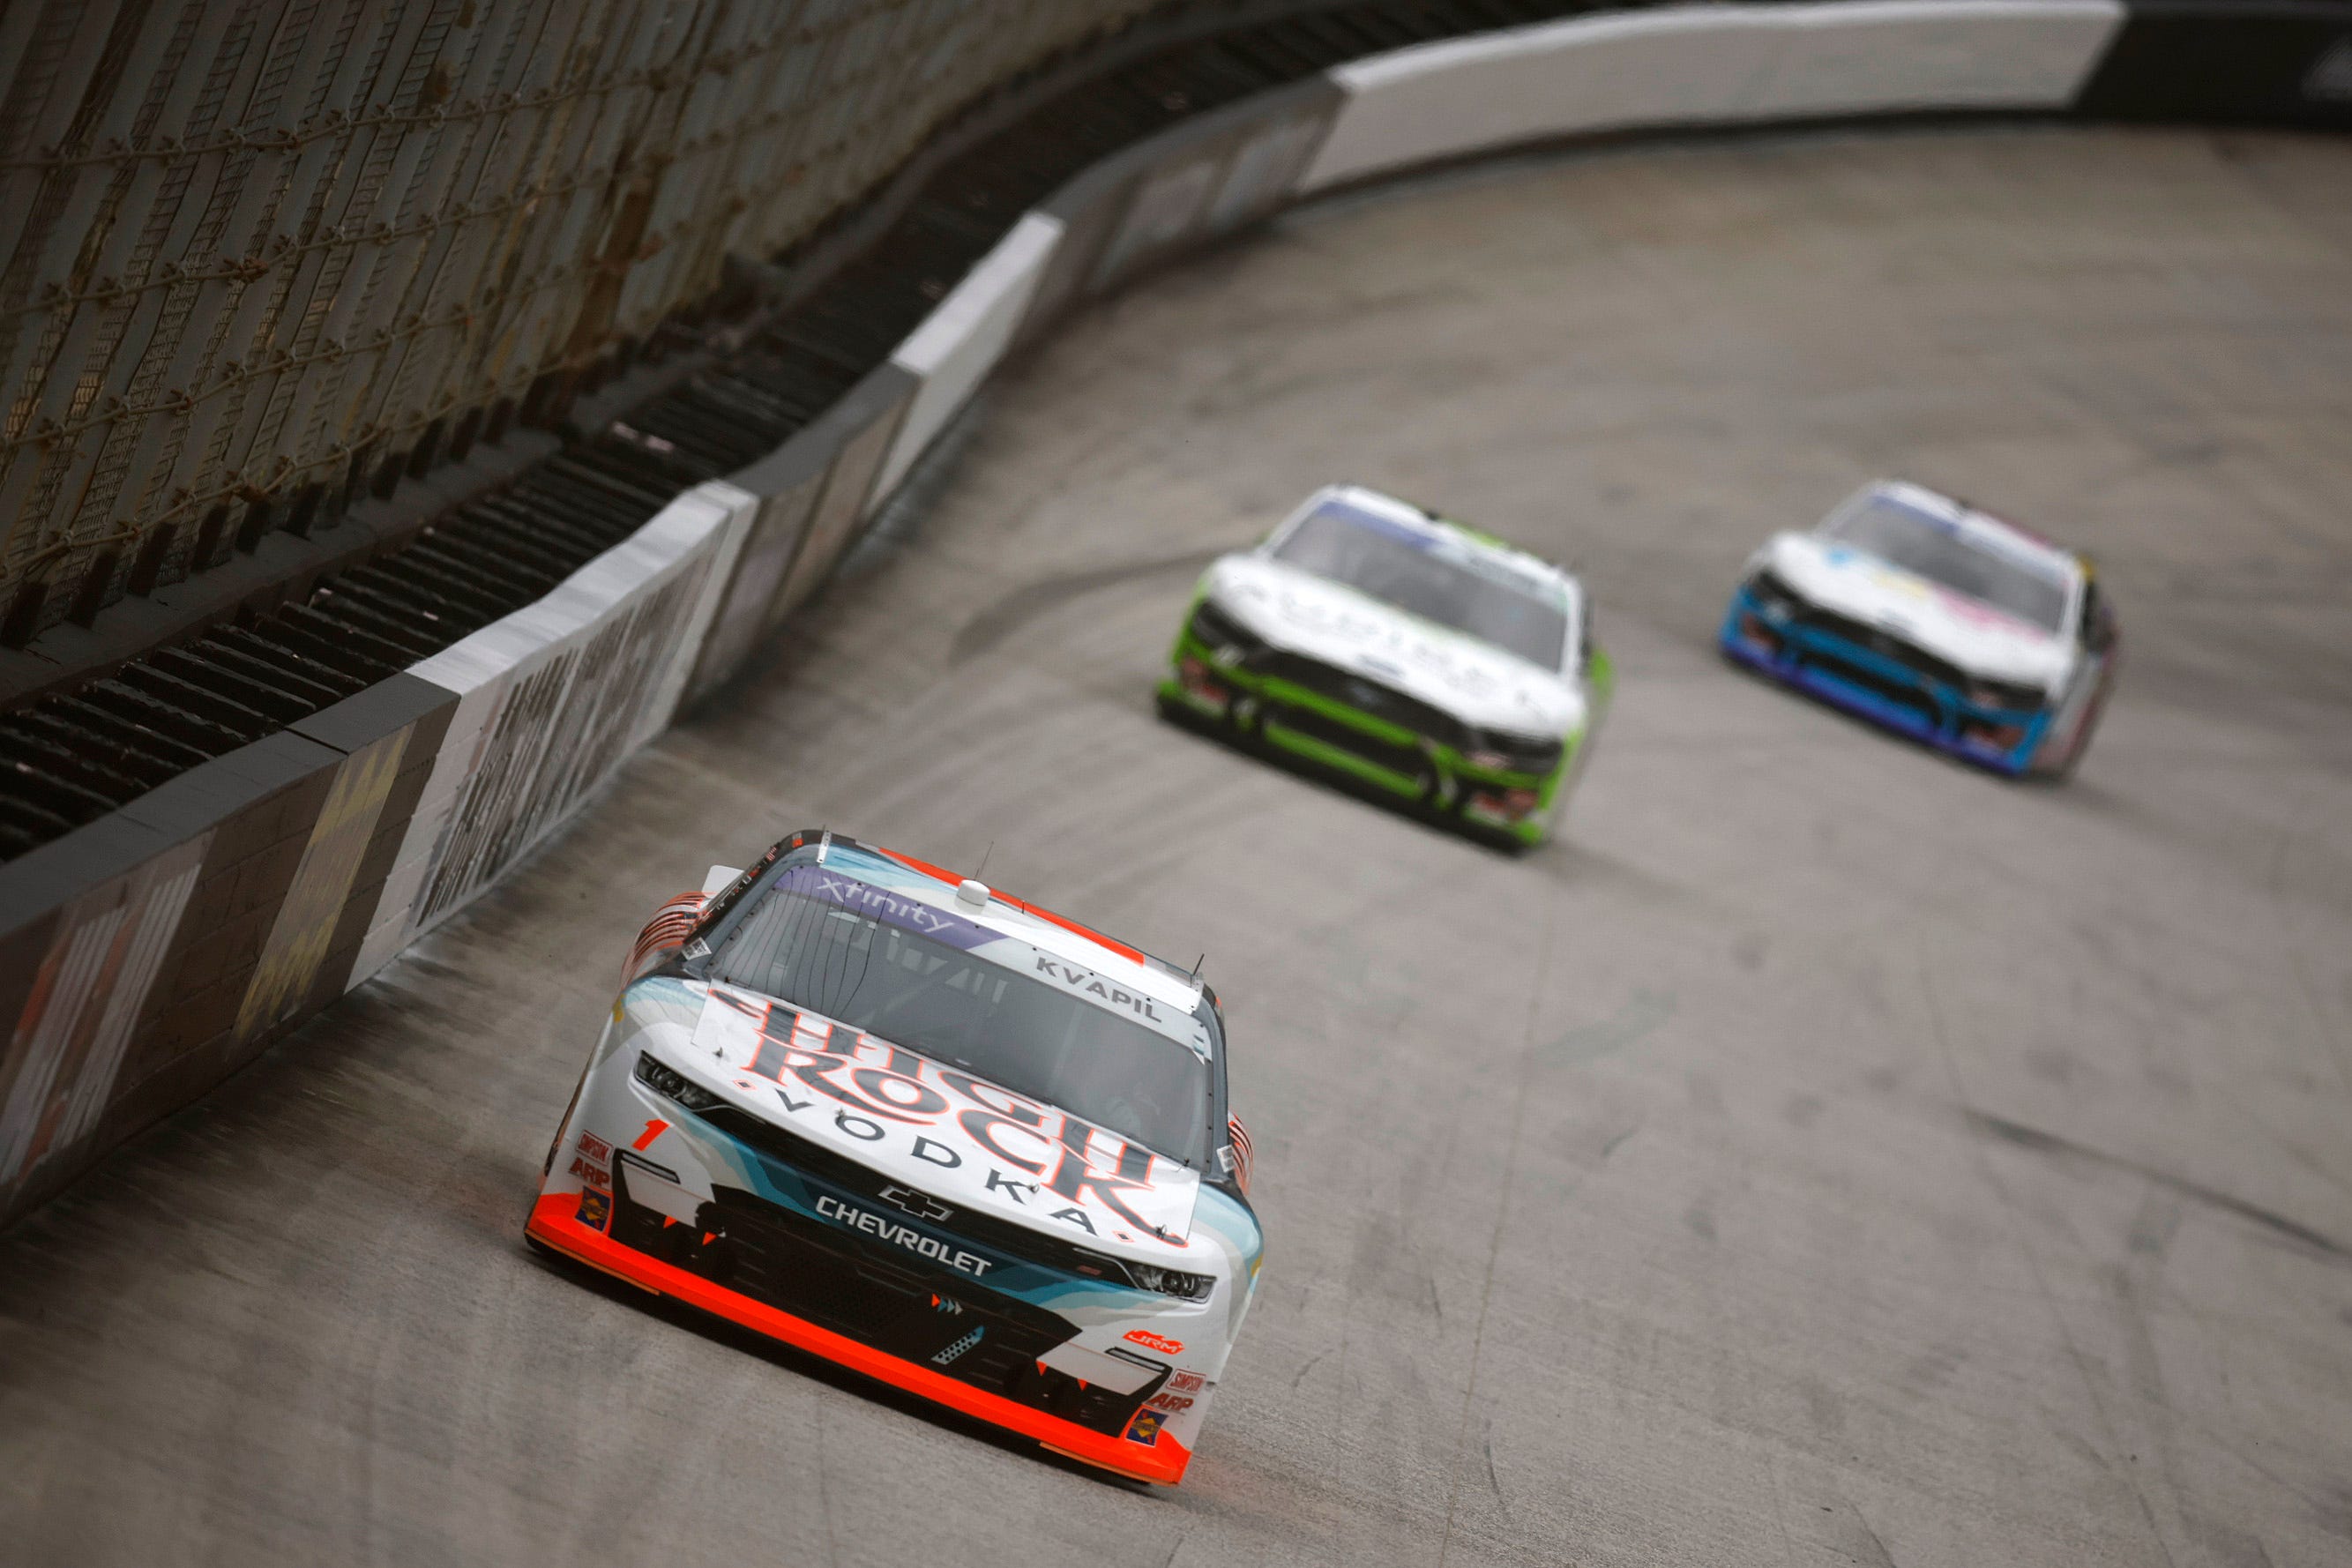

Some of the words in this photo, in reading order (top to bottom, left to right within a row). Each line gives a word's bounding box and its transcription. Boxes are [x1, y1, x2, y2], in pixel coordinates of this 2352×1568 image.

[818, 877, 955, 933] xfinity
[1036, 957, 1162, 1023] KVAPIL
[631, 1118, 670, 1152] 1
[740, 1029, 1190, 1248] ROCK
[773, 1088, 1100, 1236] VODKA
[569, 1157, 610, 1186] ARP
[816, 1196, 992, 1277] CHEVROLET
[1128, 1333, 1179, 1354] JRM
[1148, 1393, 1194, 1411] ARP
